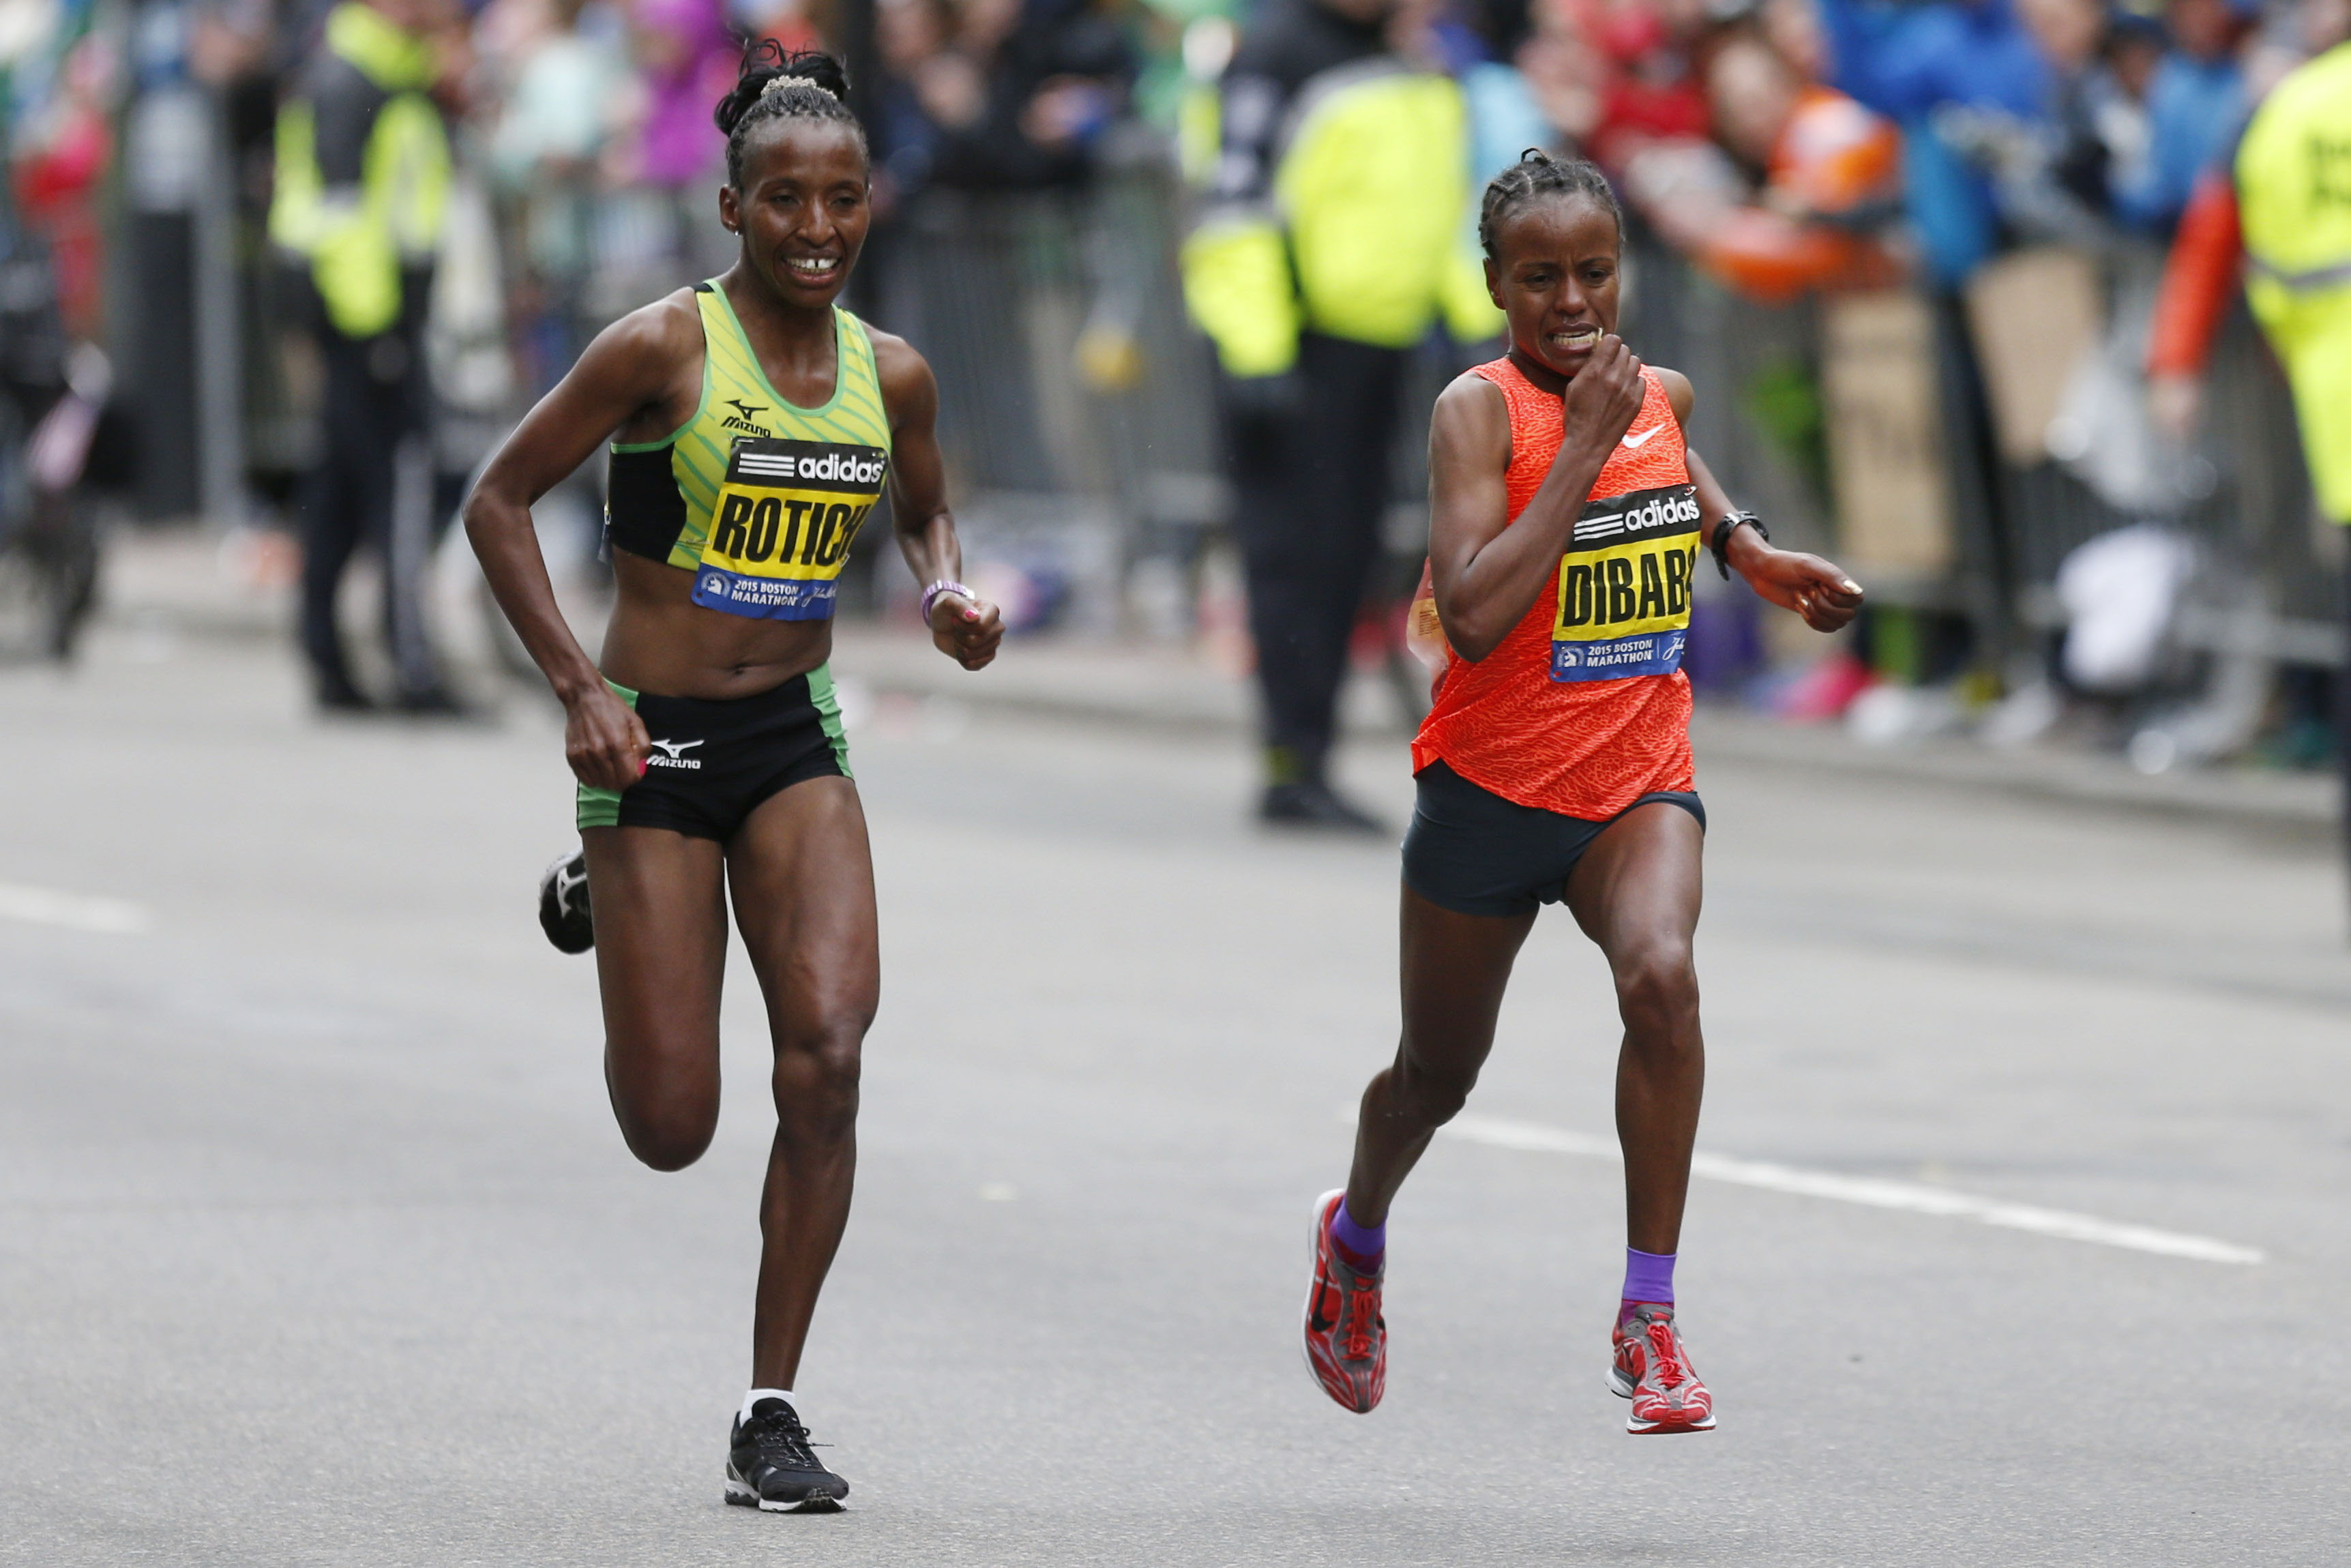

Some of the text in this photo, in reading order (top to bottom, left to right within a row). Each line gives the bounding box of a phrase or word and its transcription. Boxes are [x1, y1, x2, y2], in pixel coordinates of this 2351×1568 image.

[798, 454, 883, 484] adidas
[1625, 498, 1700, 531] adidas
[735, 580, 758, 592] 2015
[760, 582, 799, 595] BOSTON
[731, 590, 798, 606] MARATHON
[1588, 645, 1611, 656] 2015
[1613, 639, 1653, 653] BOSTON
[1586, 651, 1652, 668] MARATHON
